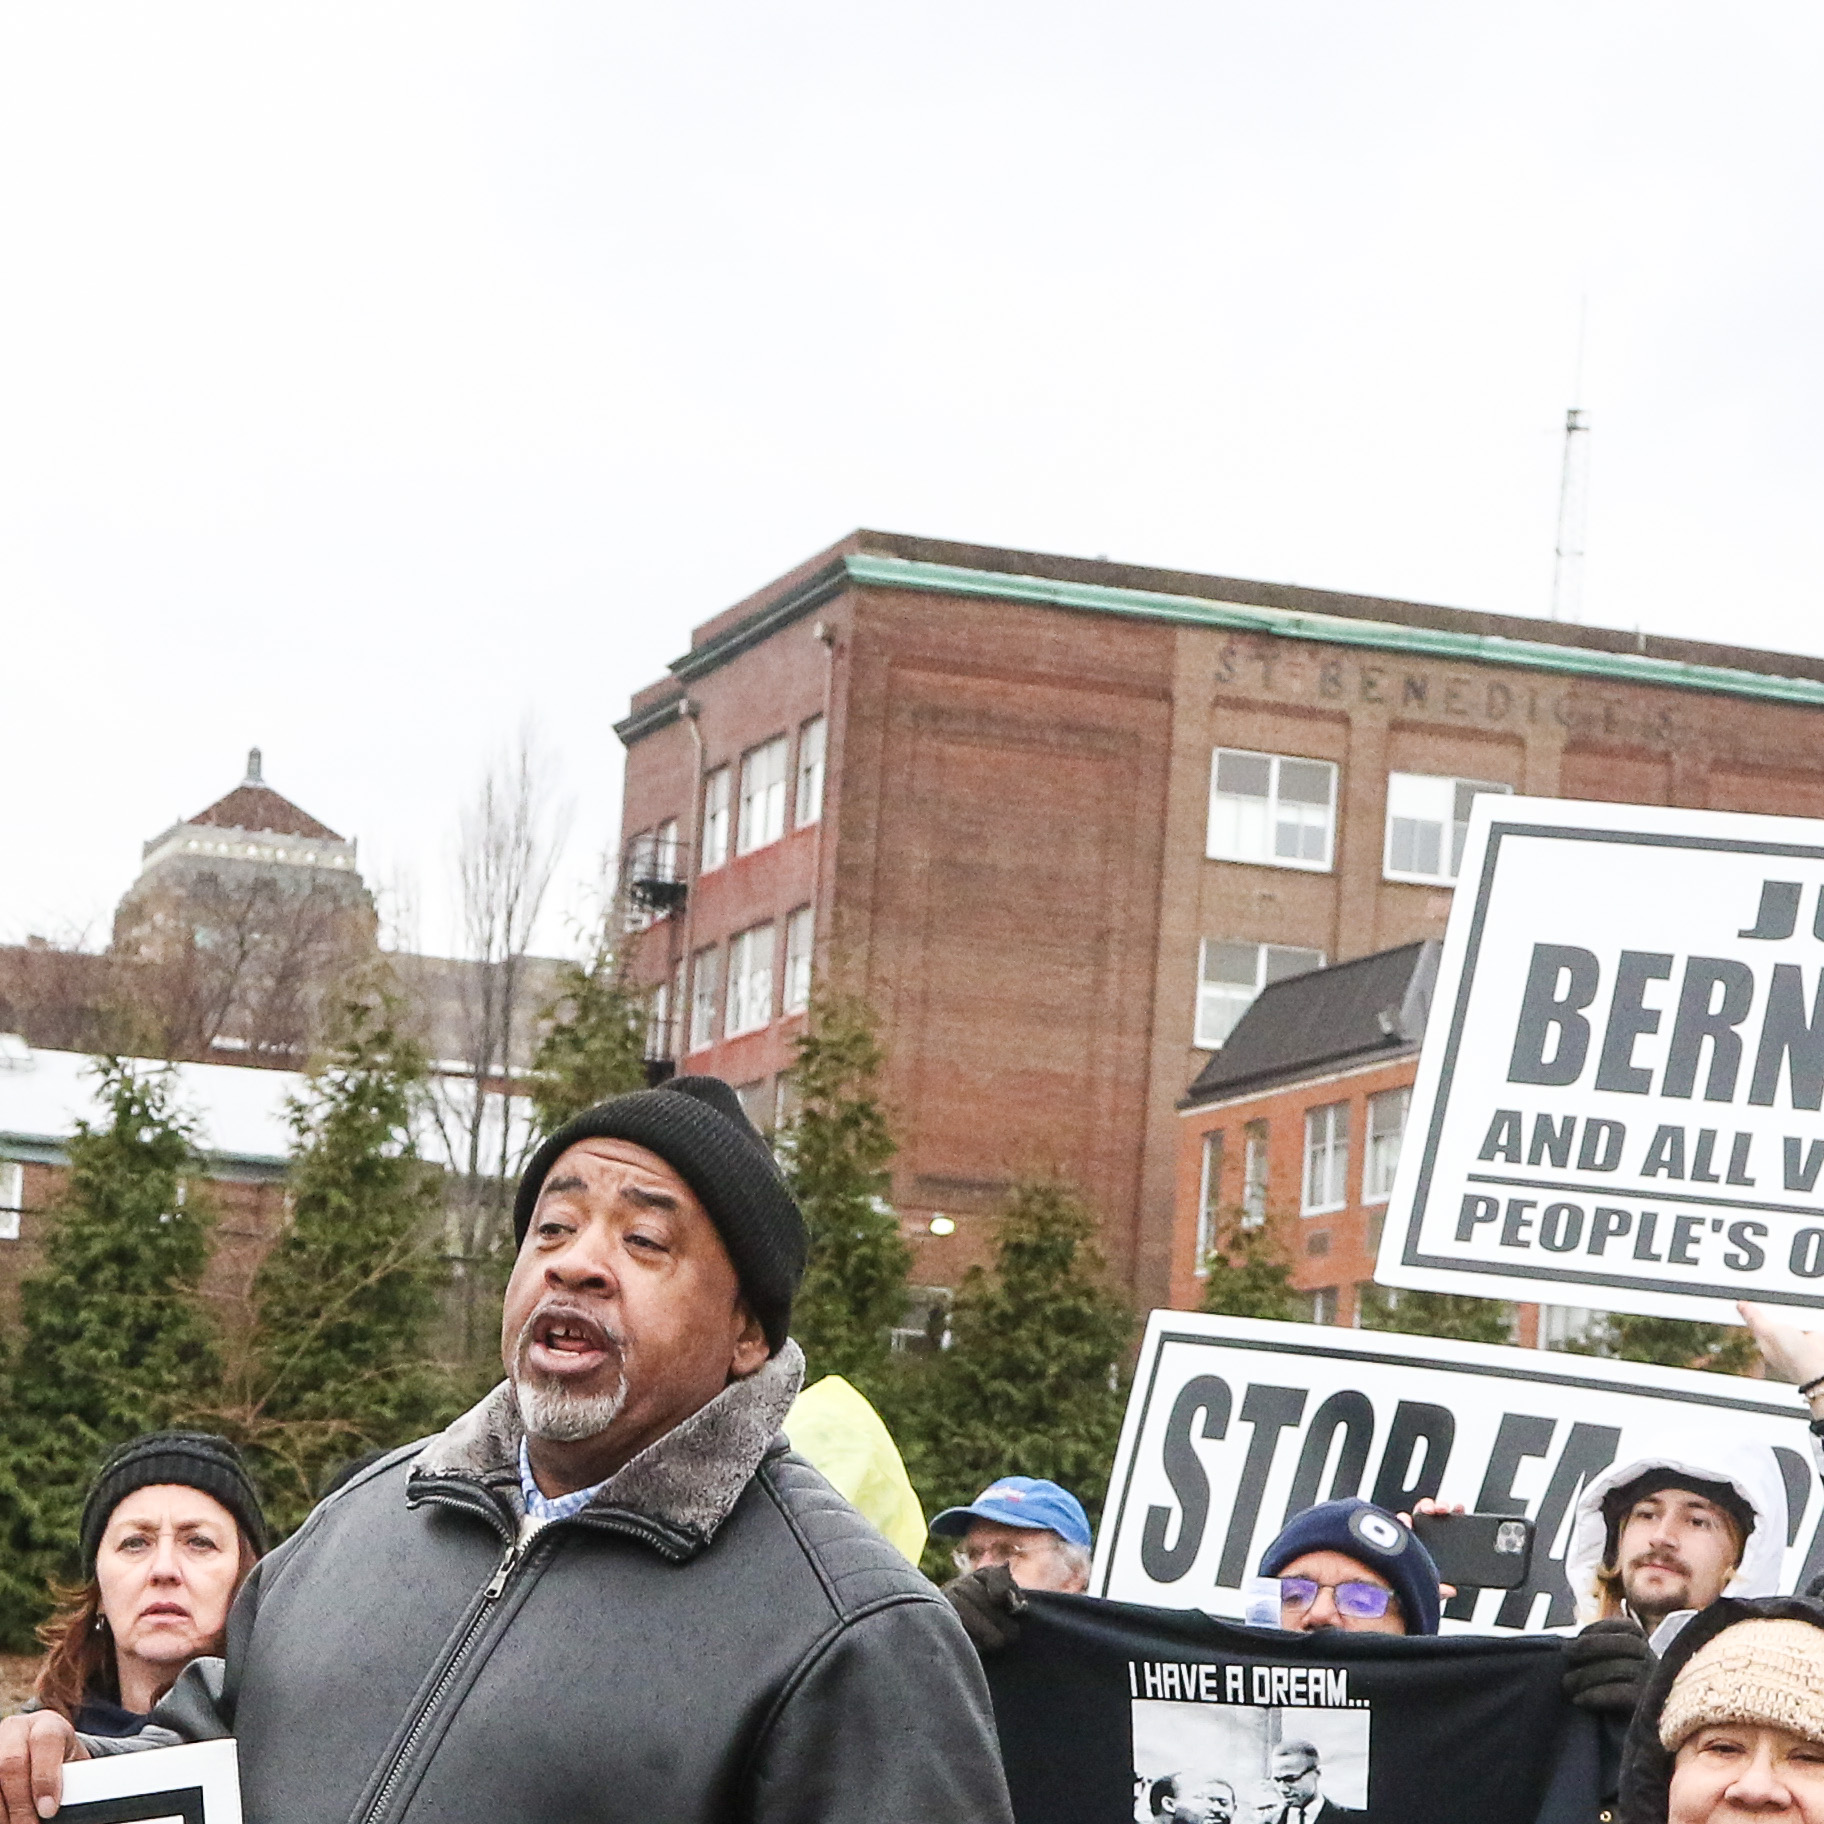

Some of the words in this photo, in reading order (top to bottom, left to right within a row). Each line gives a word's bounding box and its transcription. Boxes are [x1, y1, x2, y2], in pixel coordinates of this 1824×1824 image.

[1476, 1108, 1627, 1173] AND
[1639, 1124, 1756, 1188] ALL
[1453, 1193, 1769, 1273] PEOPLE'S
[1141, 1374, 1456, 1589] STOP
[1128, 1661, 1139, 1698] I
[1143, 1661, 1218, 1700] HAVE
[1225, 1665, 1245, 1703] A
[1252, 1666, 1370, 1708] DREAM...
